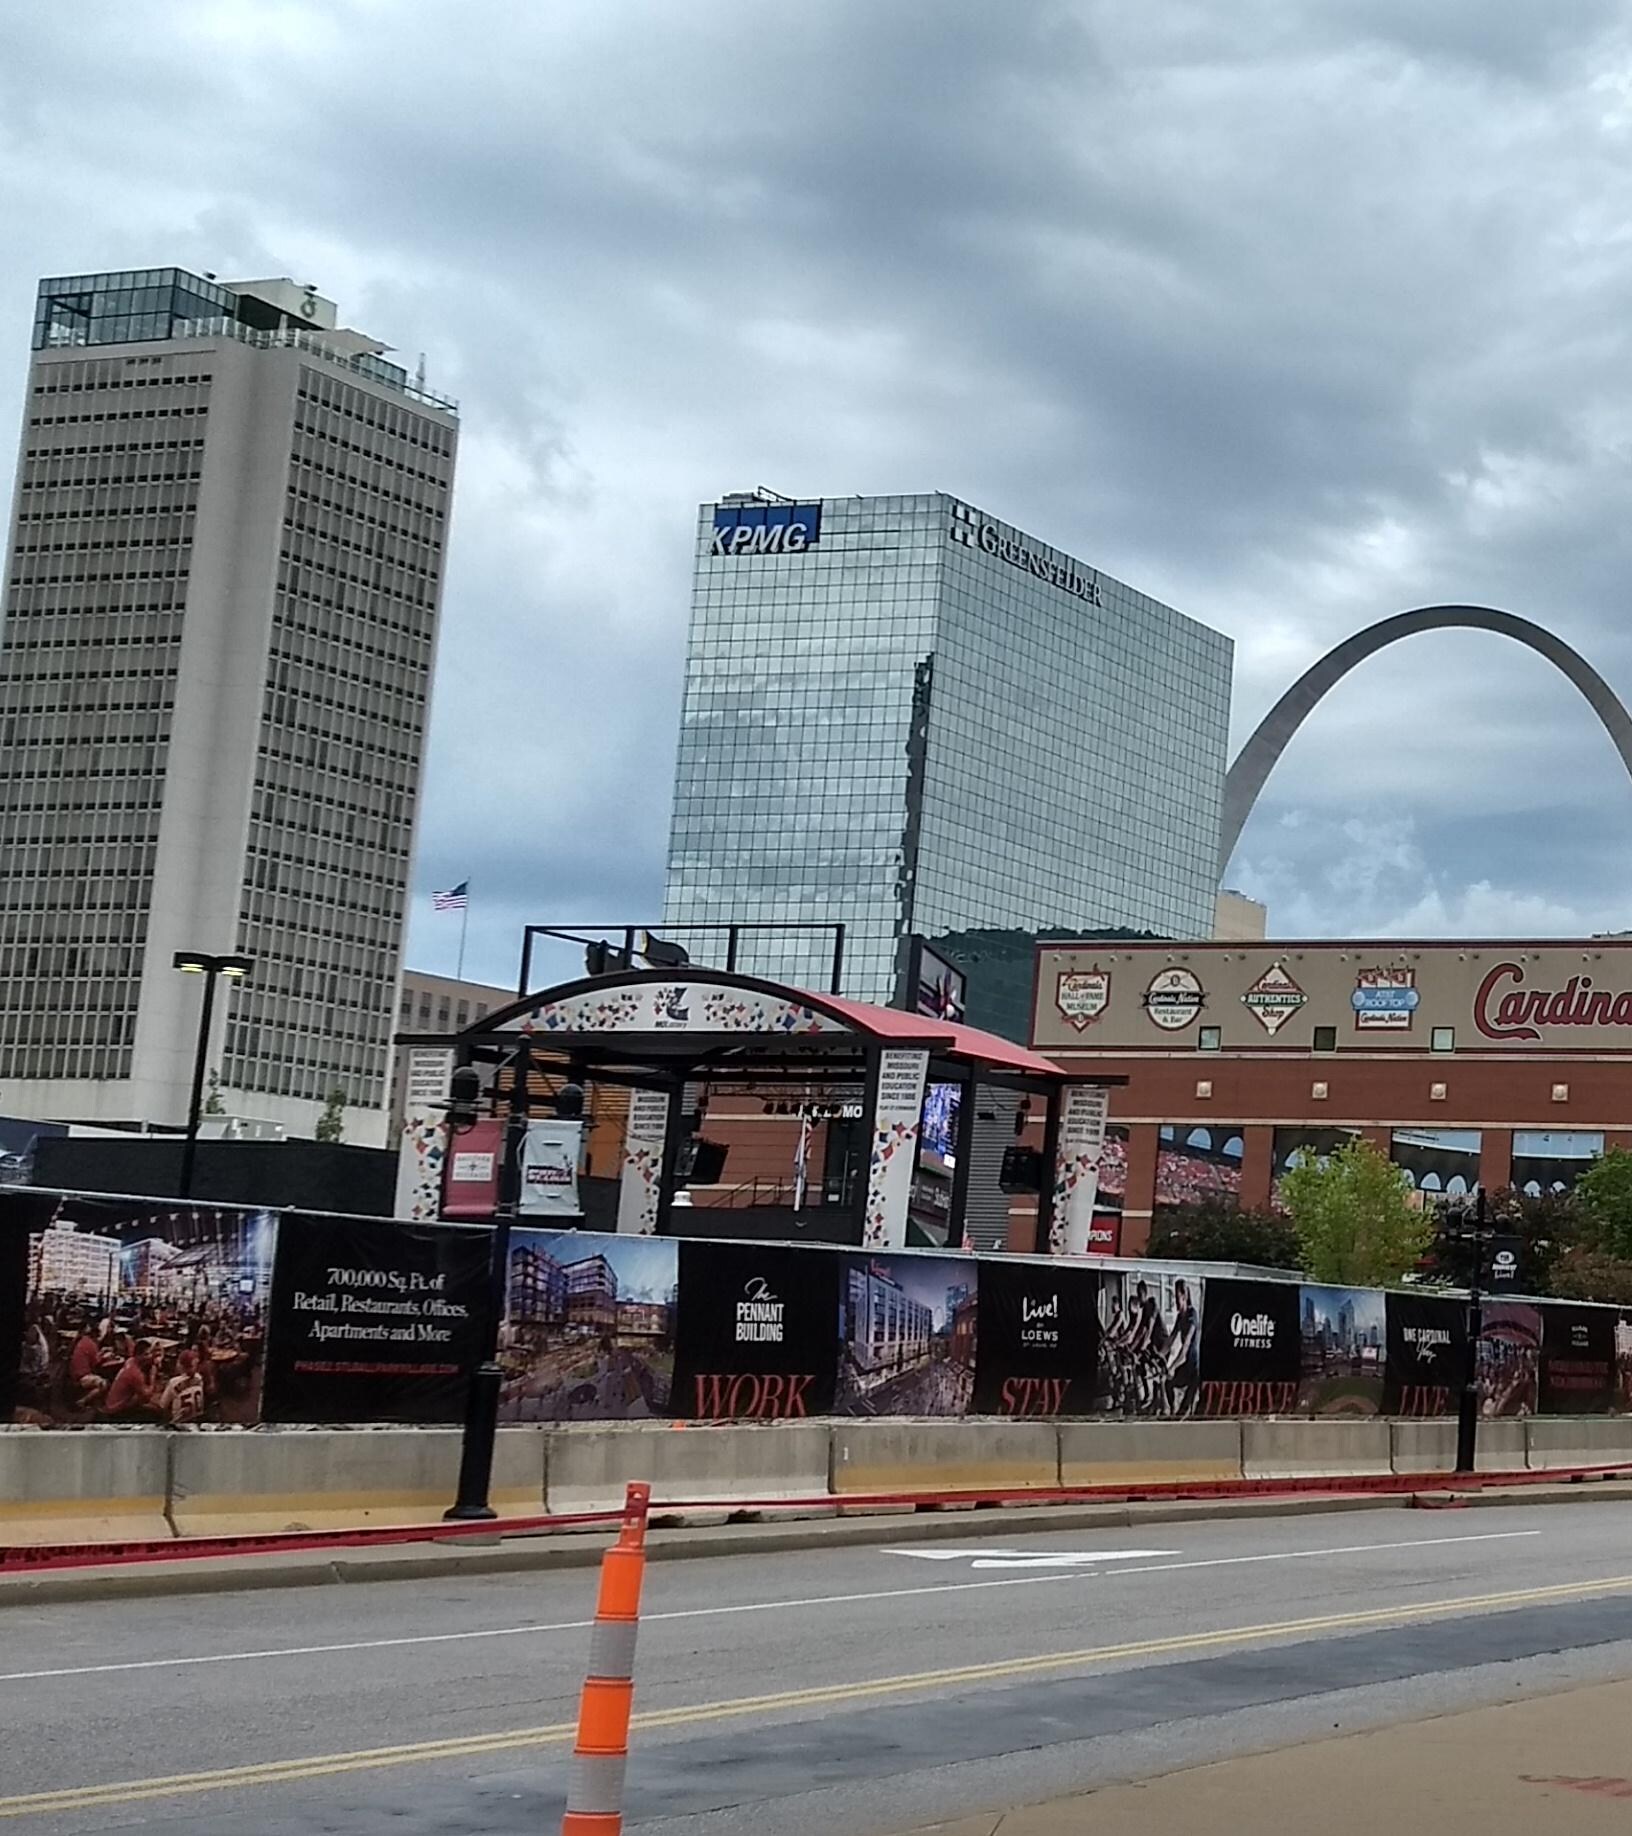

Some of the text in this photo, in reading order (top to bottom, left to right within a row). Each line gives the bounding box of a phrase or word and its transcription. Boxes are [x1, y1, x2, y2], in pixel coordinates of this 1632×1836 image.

[706, 522, 807, 556] KPMG
[977, 523, 1104, 608] GREENSFELDER
[1066, 1002, 1098, 1011] MUSEUM
[1153, 1007, 1193, 1016] Restaurant
[1247, 994, 1301, 1005] AUTHENTICS
[1261, 1004, 1286, 1020] Shop
[326, 1267, 387, 1289] 700,000
[429, 1273, 447, 1291] of
[743, 1276, 779, 1301] The
[292, 1291, 470, 1318] Retail, Restaurants, Offices,
[736, 1302, 785, 1322] PENNANT
[1022, 1294, 1059, 1322] Live!
[307, 1319, 452, 1342] Apartments and More
[735, 1322, 784, 1342] BUILDING
[1021, 1329, 1059, 1341] LOEWS
[1230, 1312, 1275, 1337] Onelife
[1233, 1337, 1273, 1349] FITNESS
[693, 1373, 816, 1418] WORK
[1000, 1376, 1072, 1416] STAY
[1202, 1380, 1300, 1416] THRIVE
